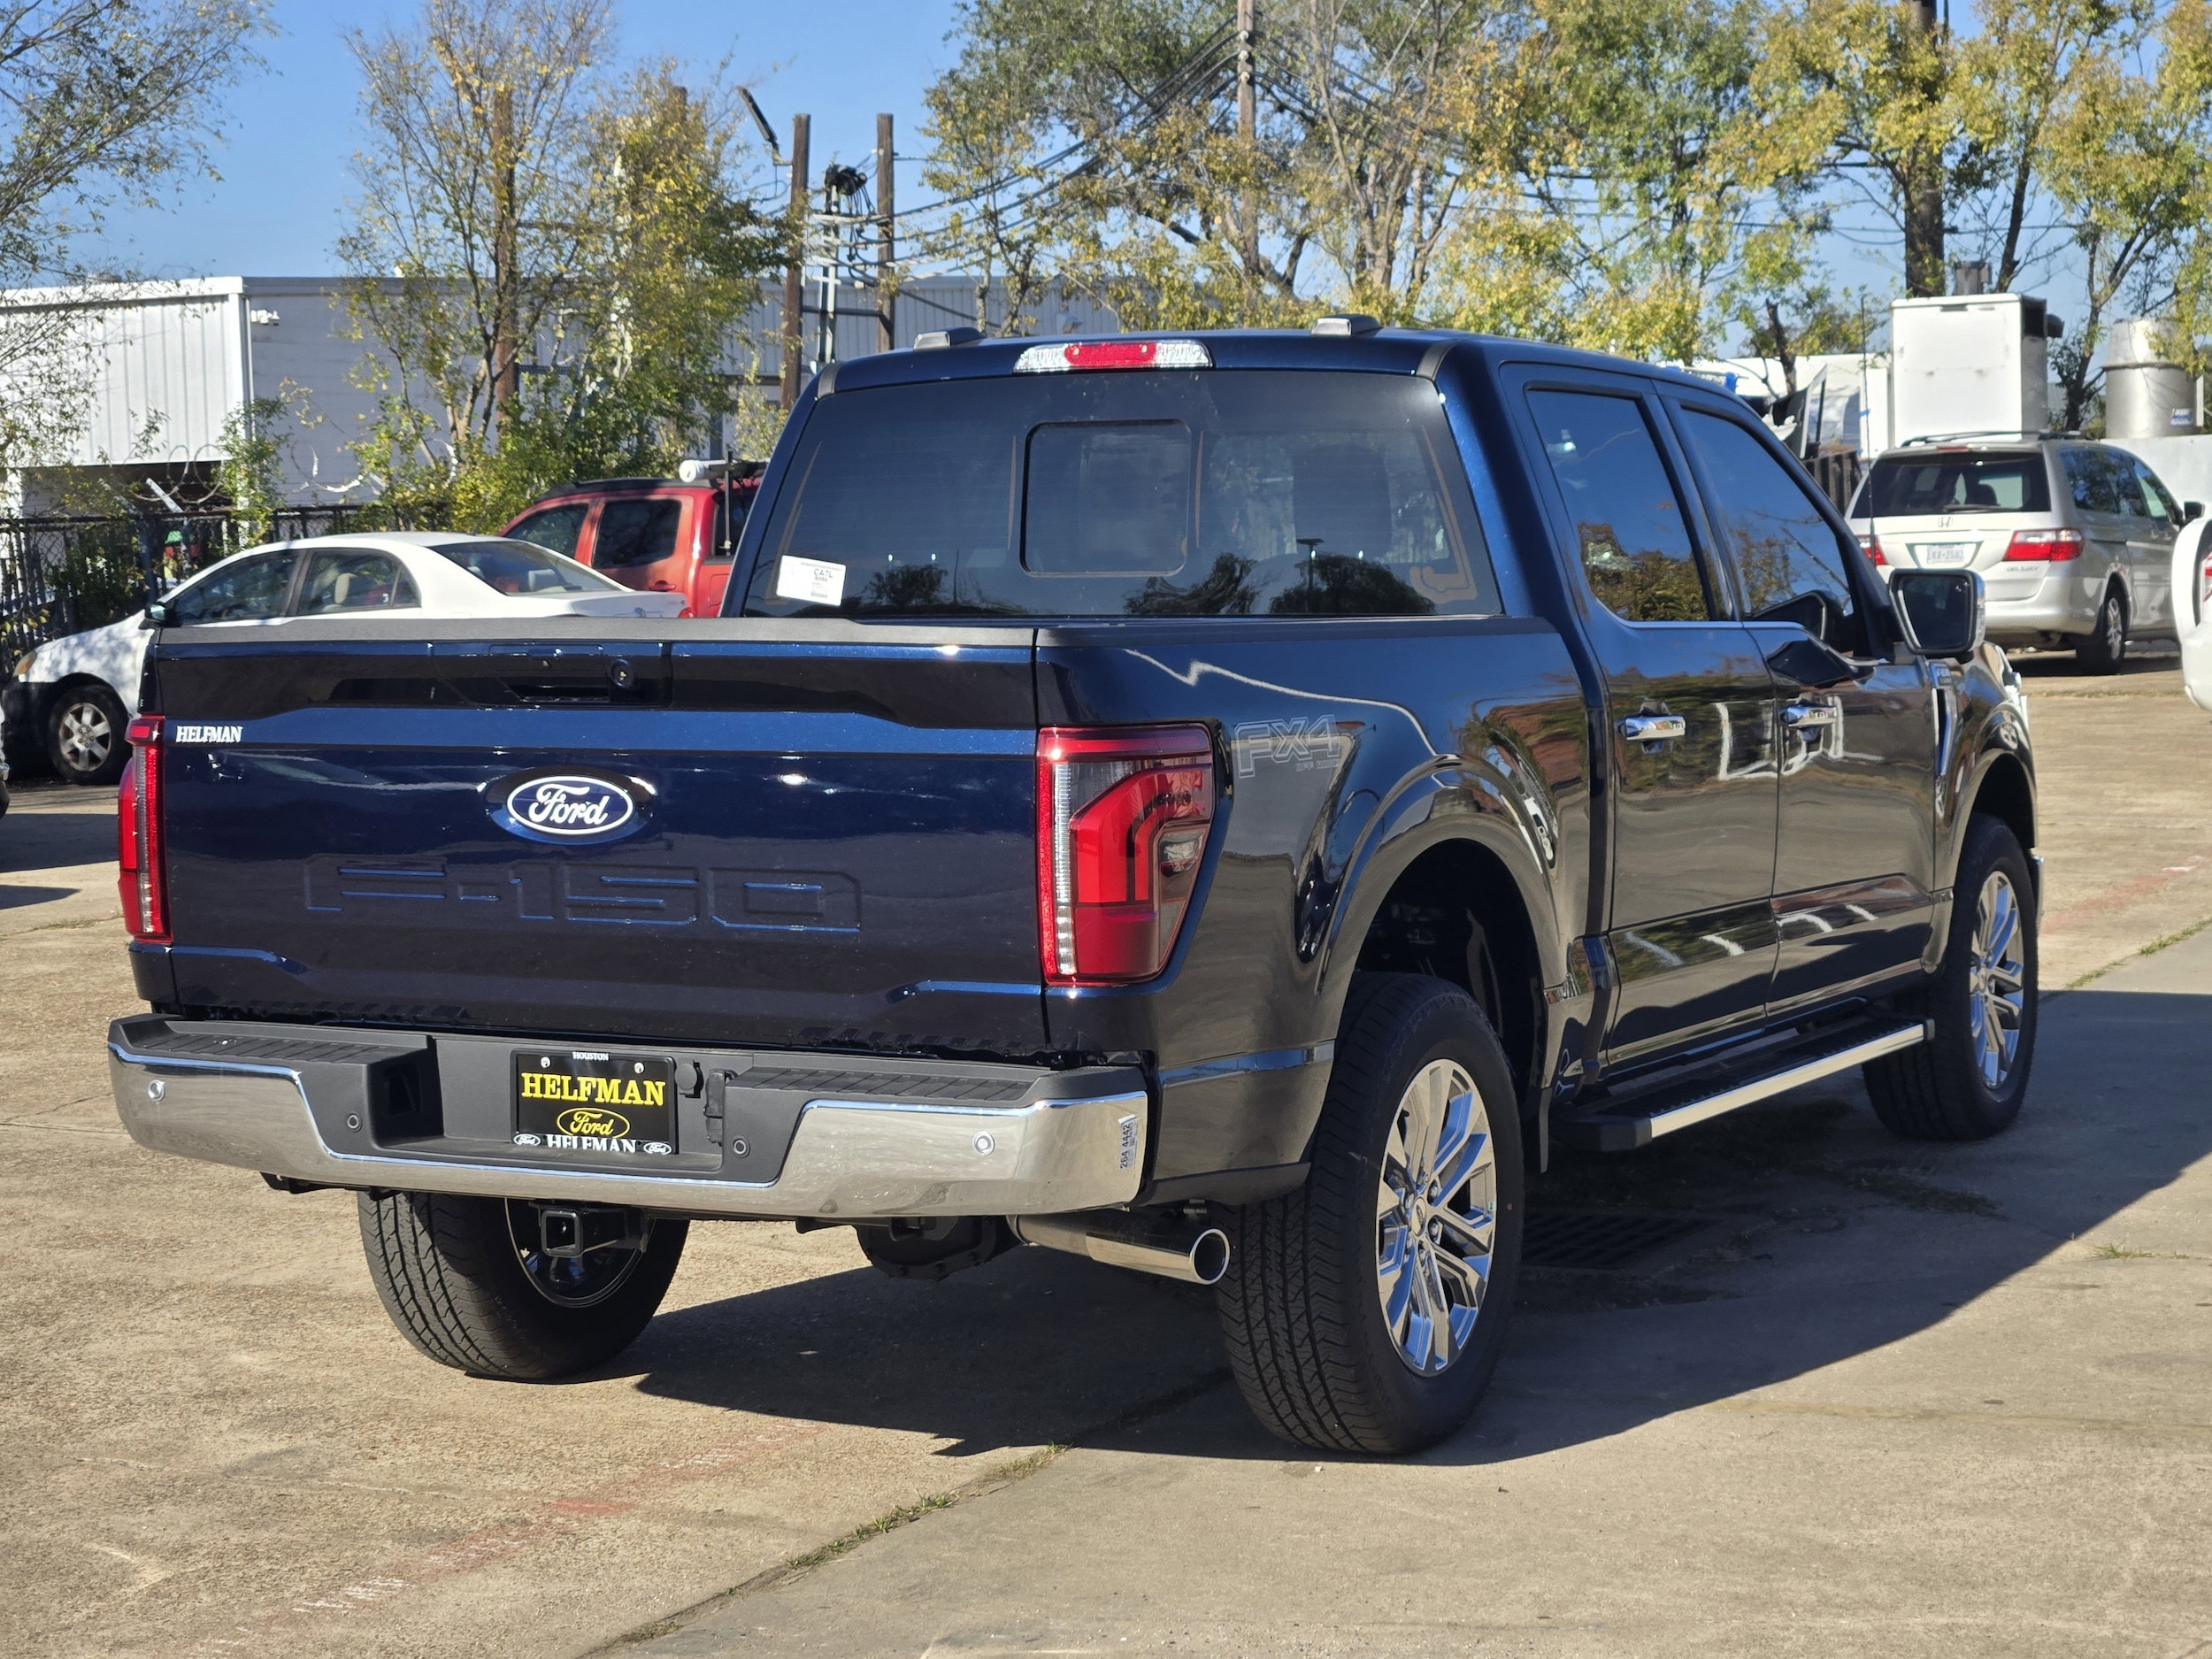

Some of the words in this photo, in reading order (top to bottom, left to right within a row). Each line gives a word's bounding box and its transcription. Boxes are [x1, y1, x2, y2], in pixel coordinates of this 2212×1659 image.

[175, 726, 243, 742] HELFMAN
[1234, 714, 1340, 779] FX4
[528, 783, 611, 825] Ford
[305, 856, 863, 933] F-150
[572, 1051, 610, 1061] HOUSTON
[521, 1072, 665, 1106] HELFMAN
[569, 1110, 615, 1135] Ford
